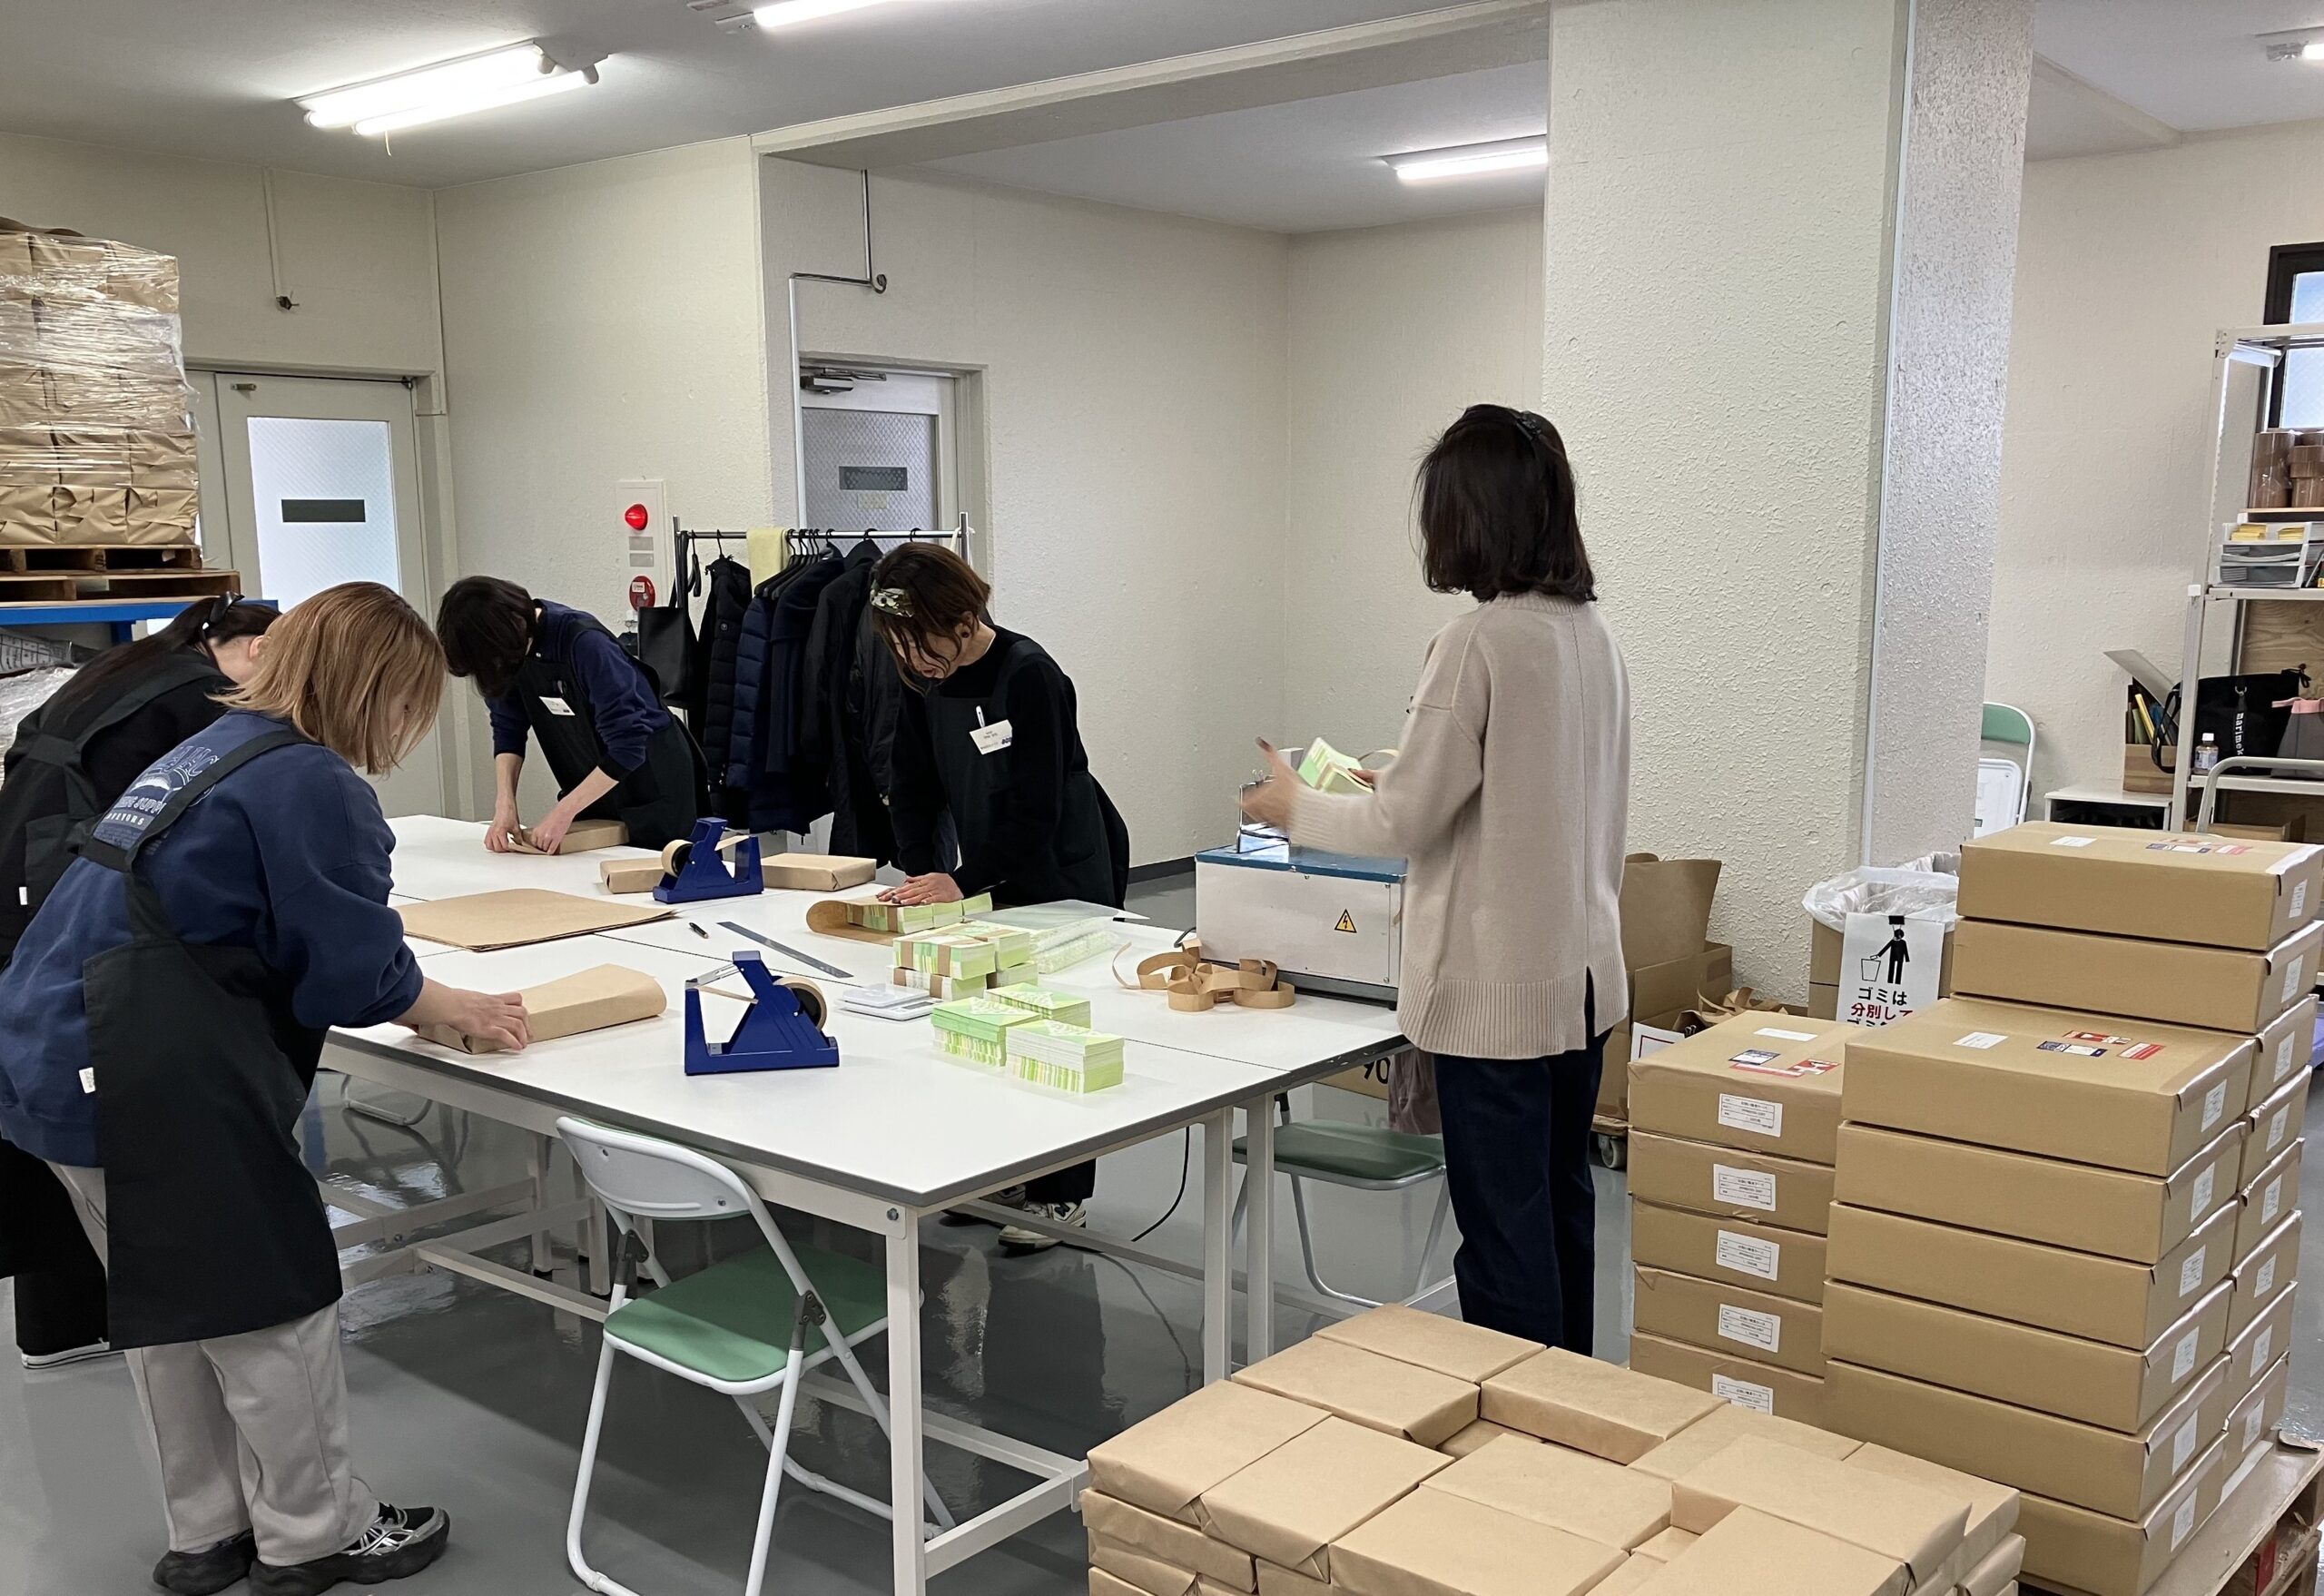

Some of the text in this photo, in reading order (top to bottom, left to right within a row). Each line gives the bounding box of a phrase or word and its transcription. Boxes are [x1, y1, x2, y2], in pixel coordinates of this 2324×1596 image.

[2235, 713, 2244, 756] marimek
[1858, 987, 1907, 1006] ゴミは
